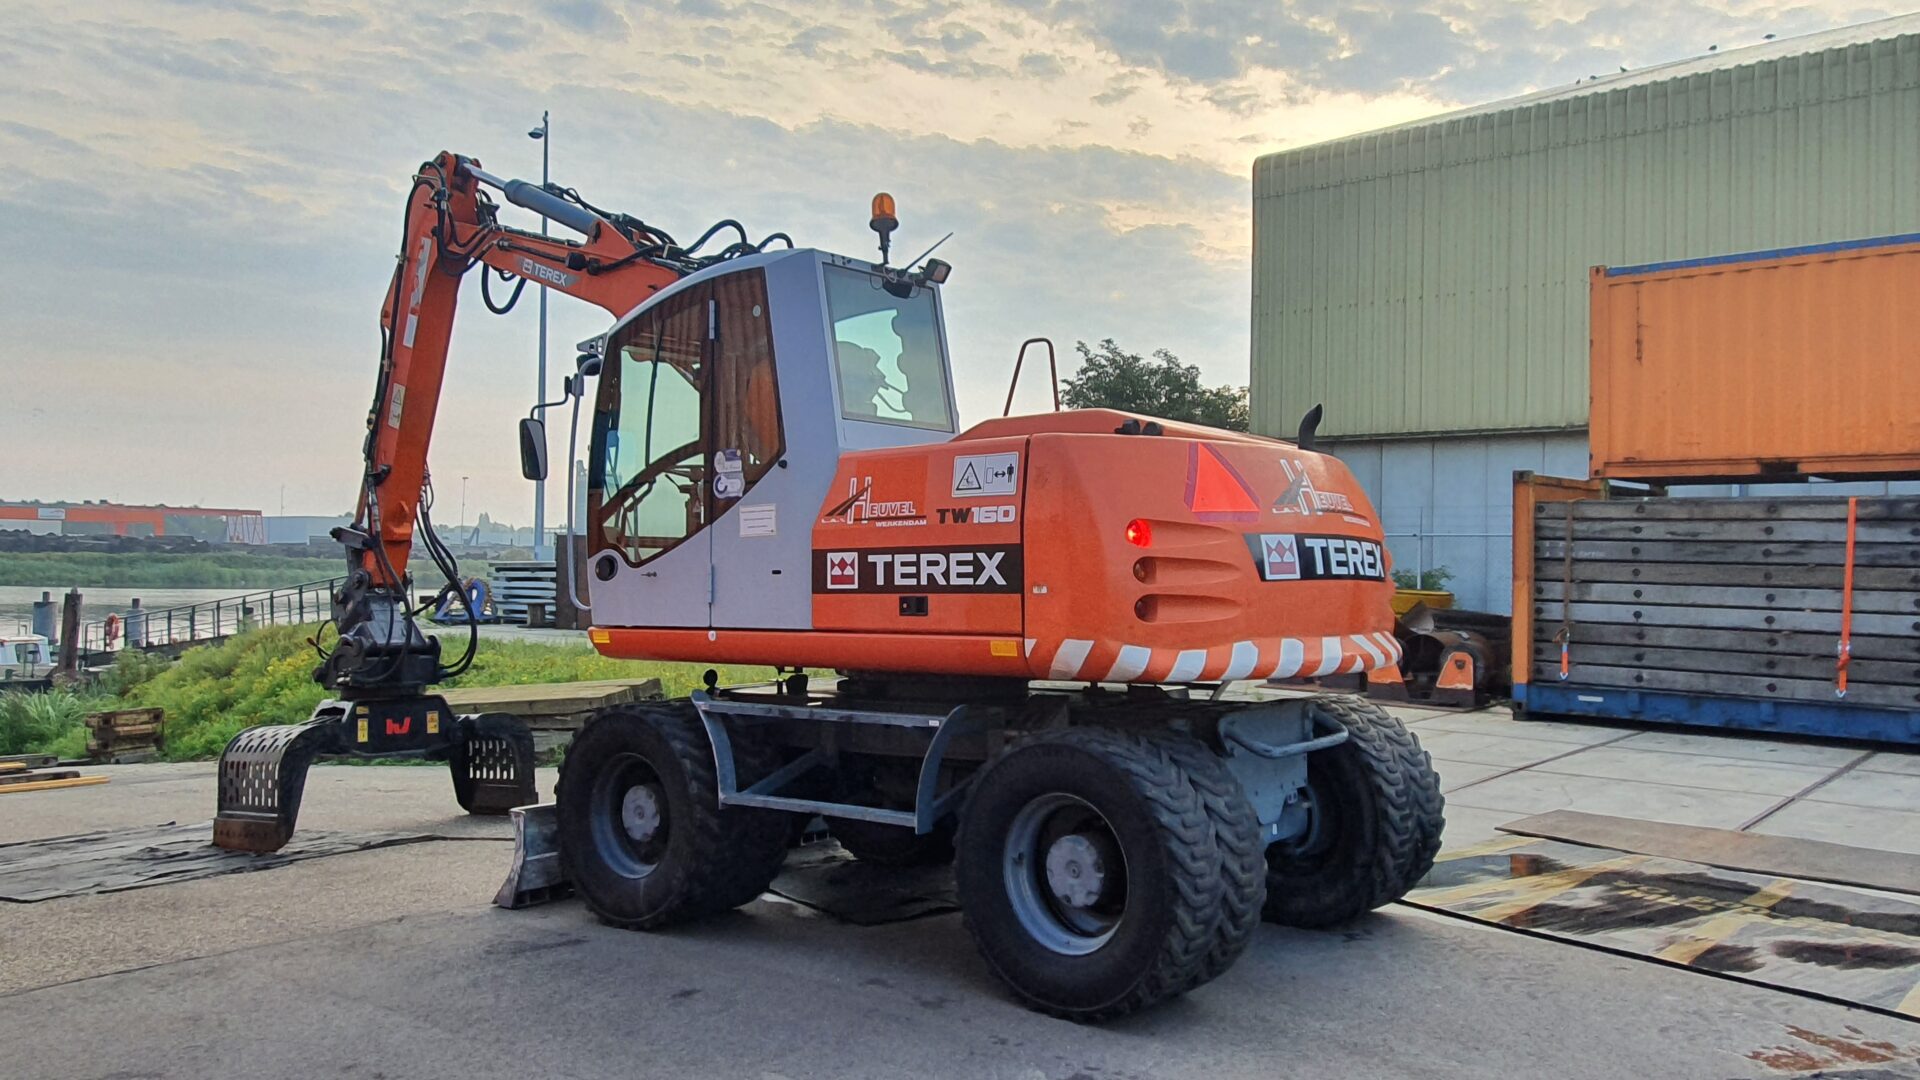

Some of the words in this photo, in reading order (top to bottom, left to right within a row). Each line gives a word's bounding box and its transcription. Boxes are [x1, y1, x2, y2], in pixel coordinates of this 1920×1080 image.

[534, 262, 567, 287] TEREX
[847, 476, 916, 524] HEUVEL
[936, 505, 1016, 524] TW160
[867, 551, 1008, 586] TEREX
[1304, 538, 1385, 578] TEREX
